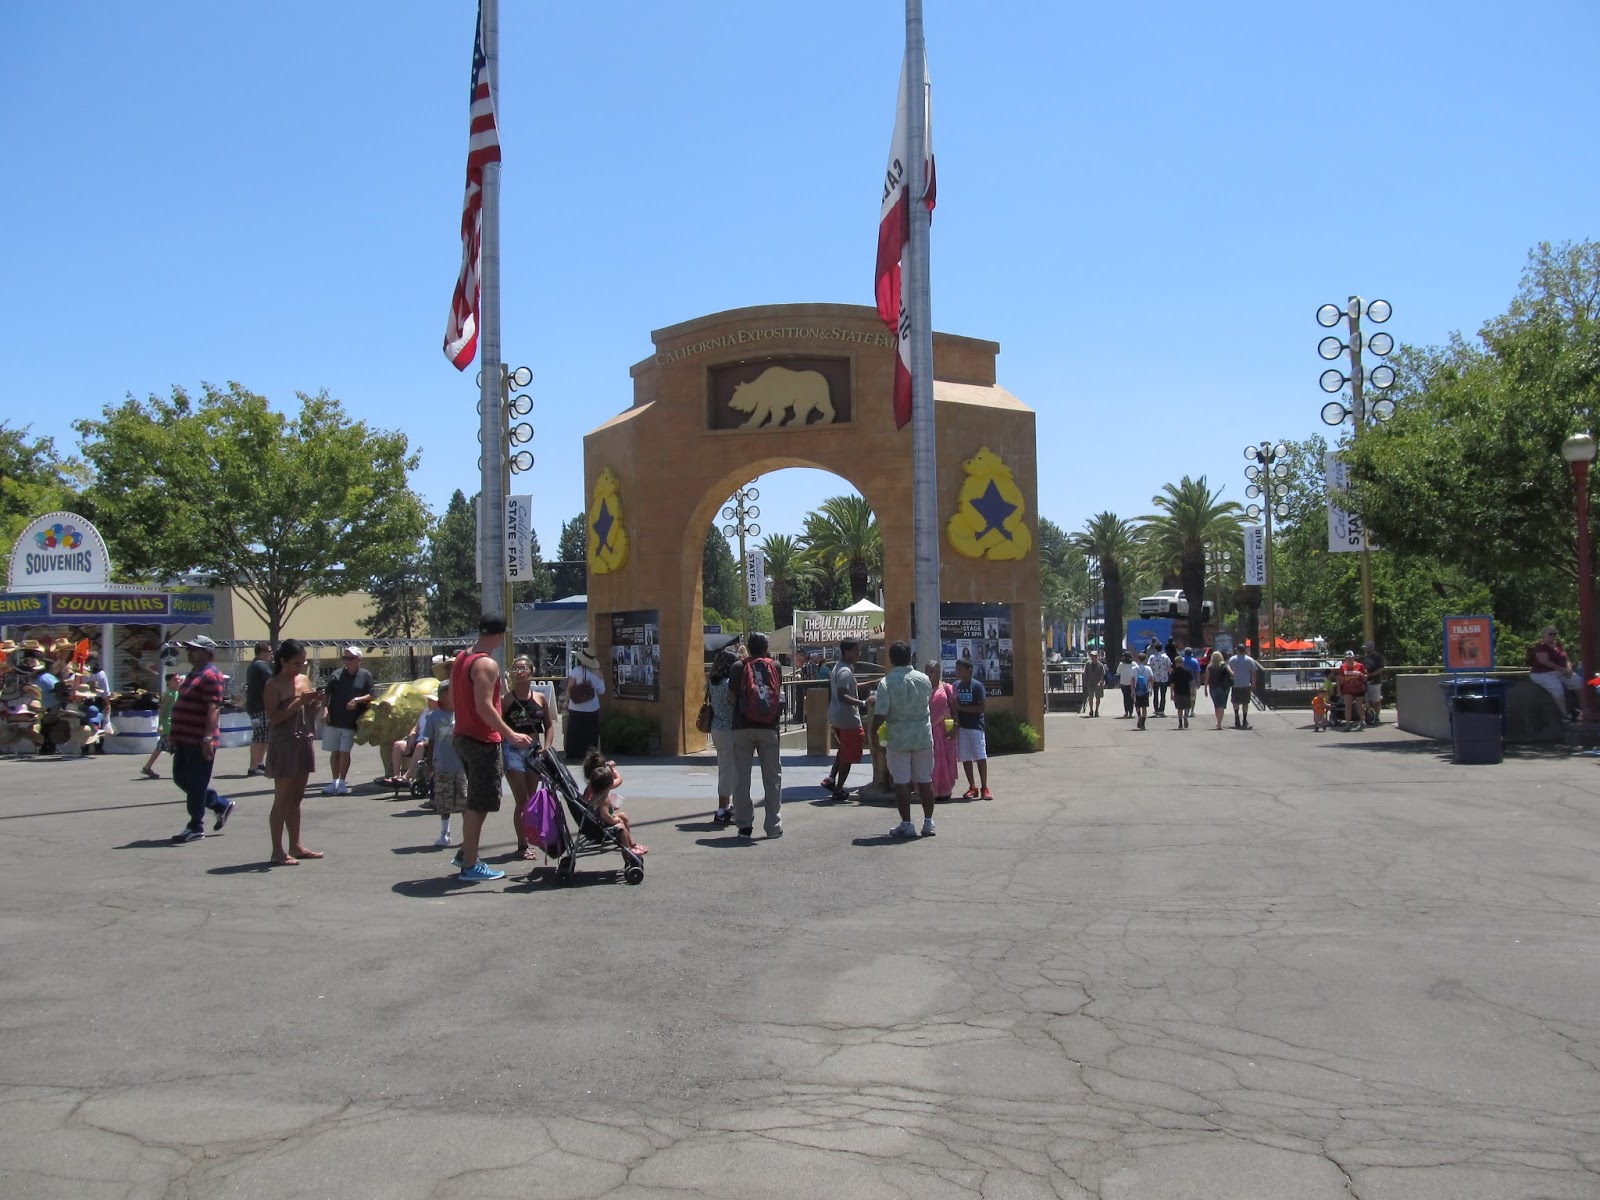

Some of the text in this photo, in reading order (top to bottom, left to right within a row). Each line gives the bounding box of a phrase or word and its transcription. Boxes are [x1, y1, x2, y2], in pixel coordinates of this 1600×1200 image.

[655, 334, 736, 367] CALIFORNIA
[738, 327, 819, 344] EXPOSITION
[831, 327, 873, 345] STATE
[508, 500, 518, 576] STATE FAIR
[517, 505, 528, 571] California
[26, 550, 92, 576] SOUVENIRS
[1255, 528, 1264, 582] STATE FAIR
[748, 553, 756, 579] STATE
[56, 596, 164, 612] SOUVENIRS
[172, 598, 212, 612] SOUVENIRS
[804, 615, 870, 630] THE ULTIMATE
[873, 624, 885, 634] GI
[1452, 625, 1480, 633] TRASH
[804, 630, 869, 642] FAN EXPERIENCE
